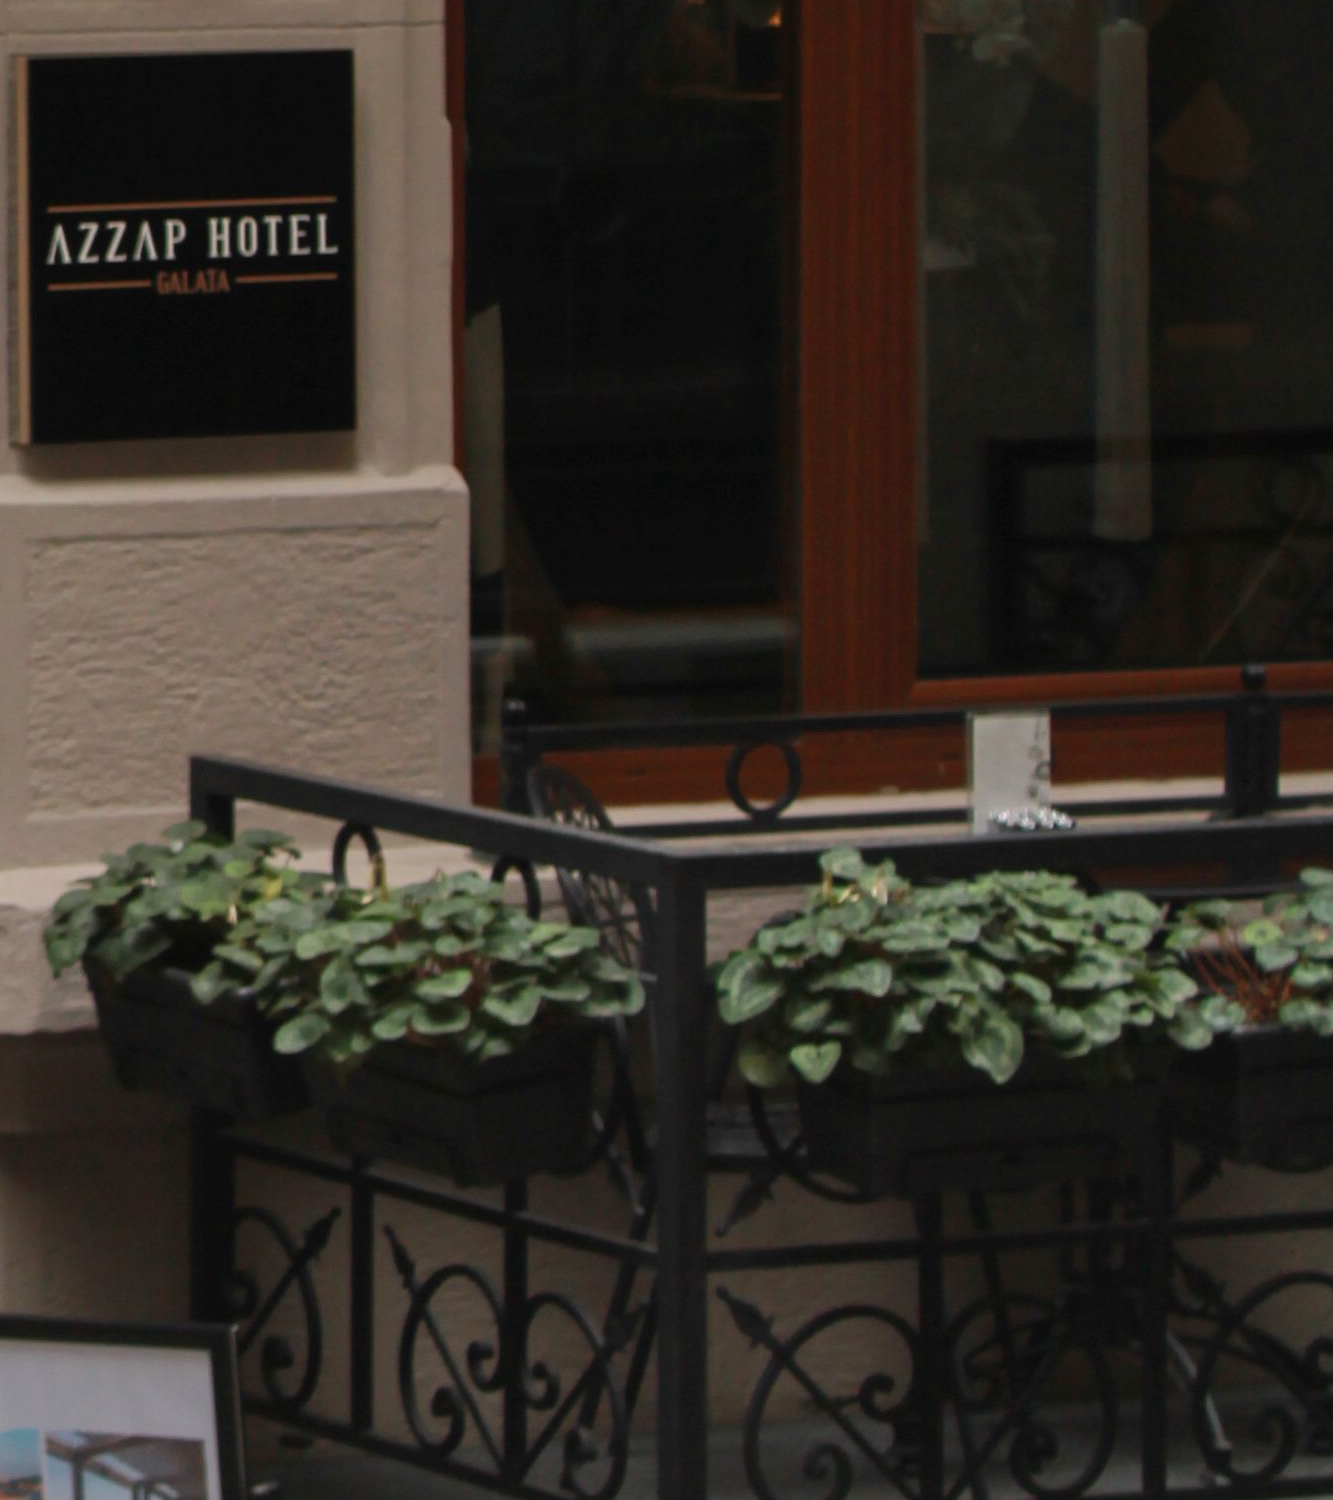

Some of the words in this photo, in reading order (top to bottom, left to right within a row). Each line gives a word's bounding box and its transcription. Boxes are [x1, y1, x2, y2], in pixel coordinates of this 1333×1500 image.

[45, 219, 188, 265] AZZAP
[207, 213, 339, 259] HOTEL
[155, 269, 230, 295] GALATA
